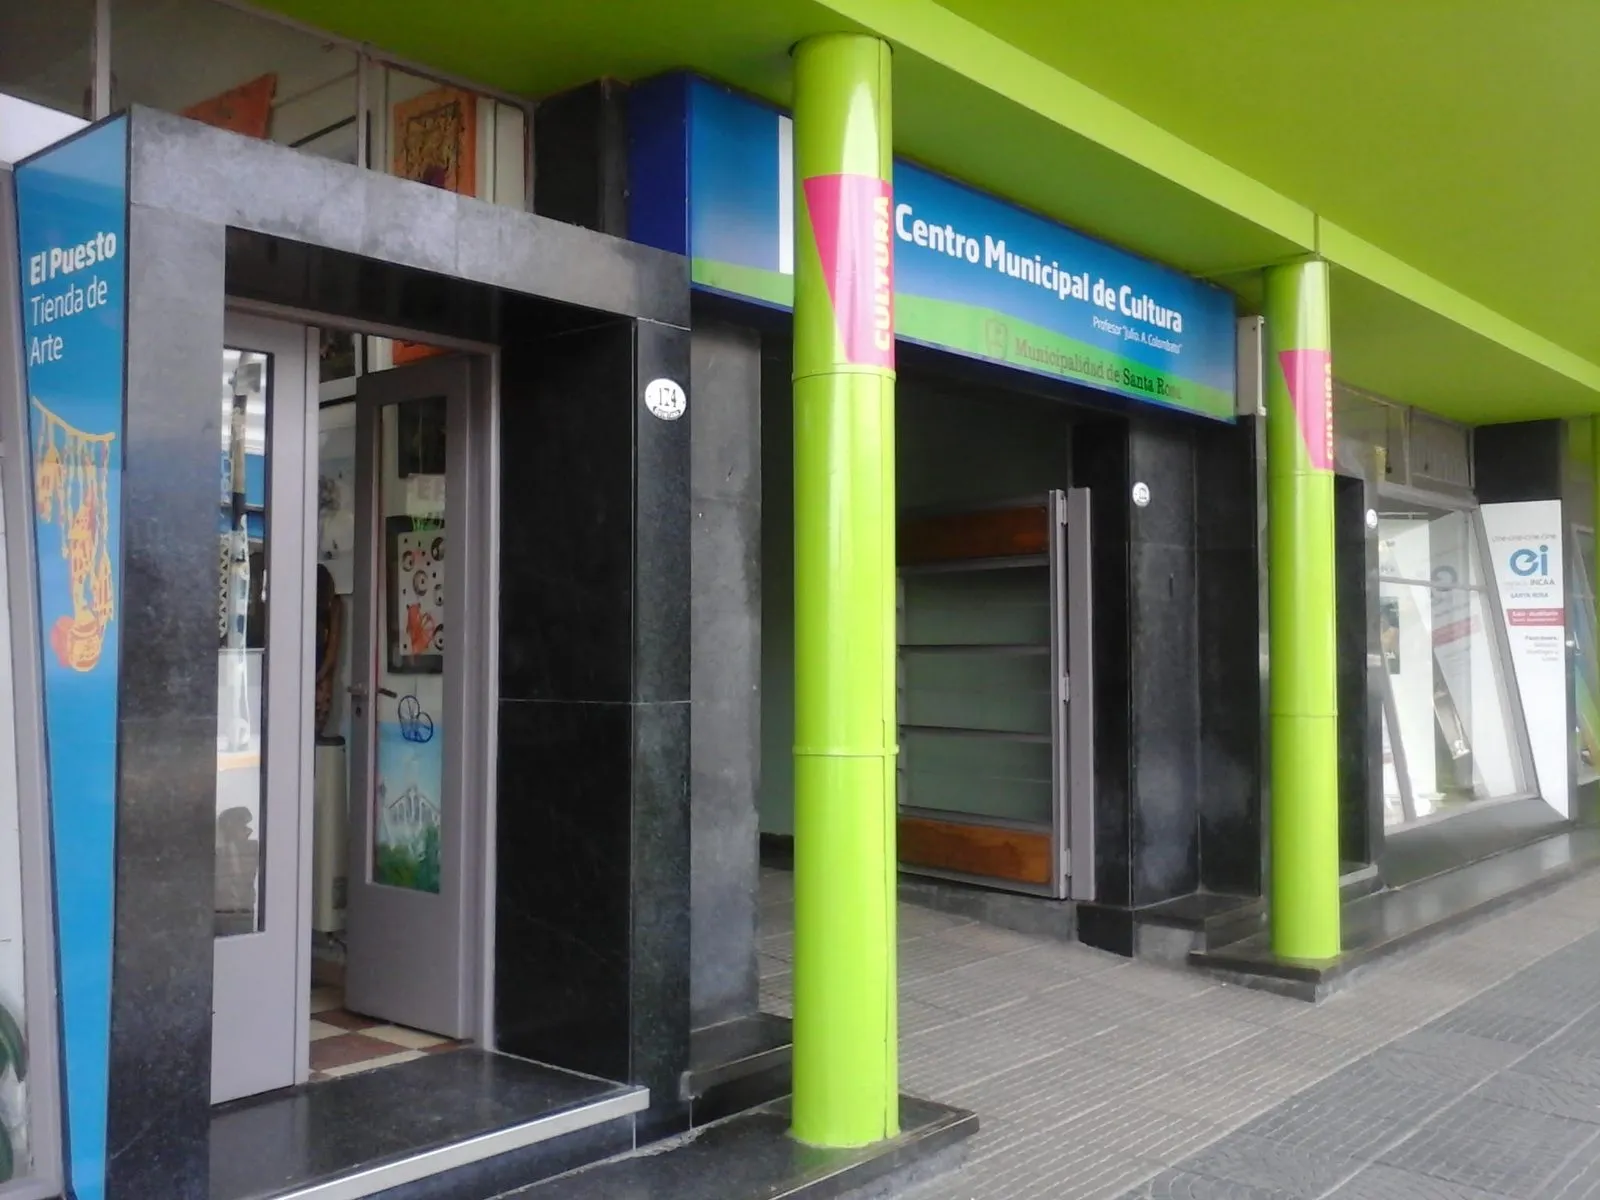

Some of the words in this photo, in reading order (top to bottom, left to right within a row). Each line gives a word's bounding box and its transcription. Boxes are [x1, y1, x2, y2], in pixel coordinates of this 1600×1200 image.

[30, 252, 47, 286] El
[50, 231, 117, 279] Puesto
[873, 196, 890, 352] CULTURA
[895, 203, 980, 263] Centro
[984, 234, 1089, 301] Municipal
[1092, 277, 1117, 311] de
[1119, 284, 1183, 334] Cultura
[31, 283, 84, 327] Tienda
[87, 274, 108, 310] de
[29, 333, 64, 367] Arte
[1015, 337, 1103, 379] Municipalidad
[1106, 363, 1120, 384] de
[1123, 367, 1154, 393] Santa
[1530, 578, 1556, 586] INCAA
